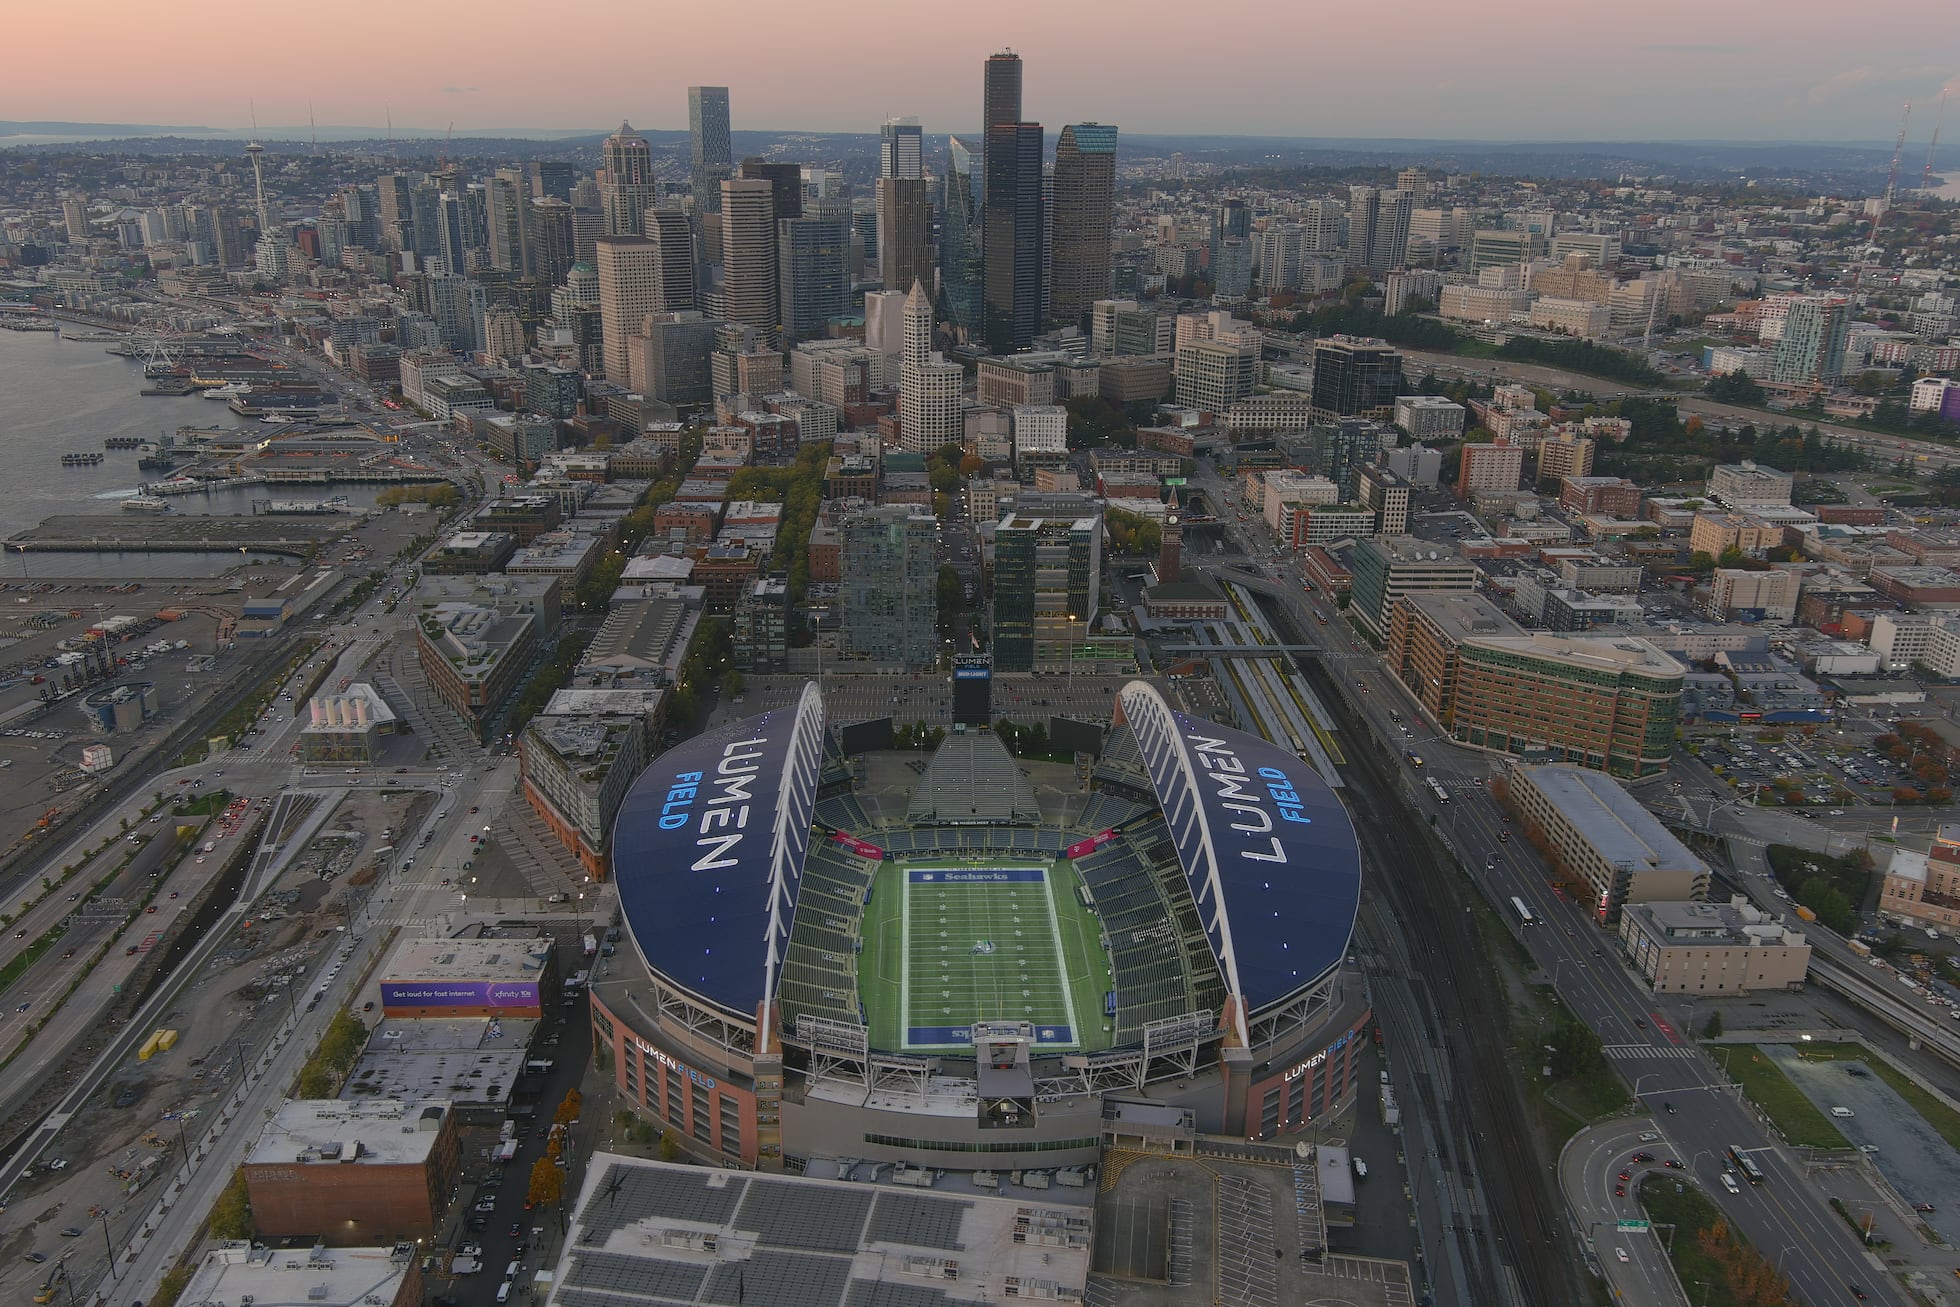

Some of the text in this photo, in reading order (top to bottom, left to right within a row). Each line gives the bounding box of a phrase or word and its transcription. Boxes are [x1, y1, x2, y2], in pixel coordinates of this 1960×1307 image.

[659, 771, 704, 830] FIELD
[690, 738, 768, 871] LUMEN
[1187, 735, 1288, 863] LUMEN
[1258, 767, 1311, 823] FIELD
[495, 990, 519, 999] xfinity
[636, 1036, 716, 1089] LUMEN FIELD
[1284, 1029, 1354, 1082] LUMEN FIELD
